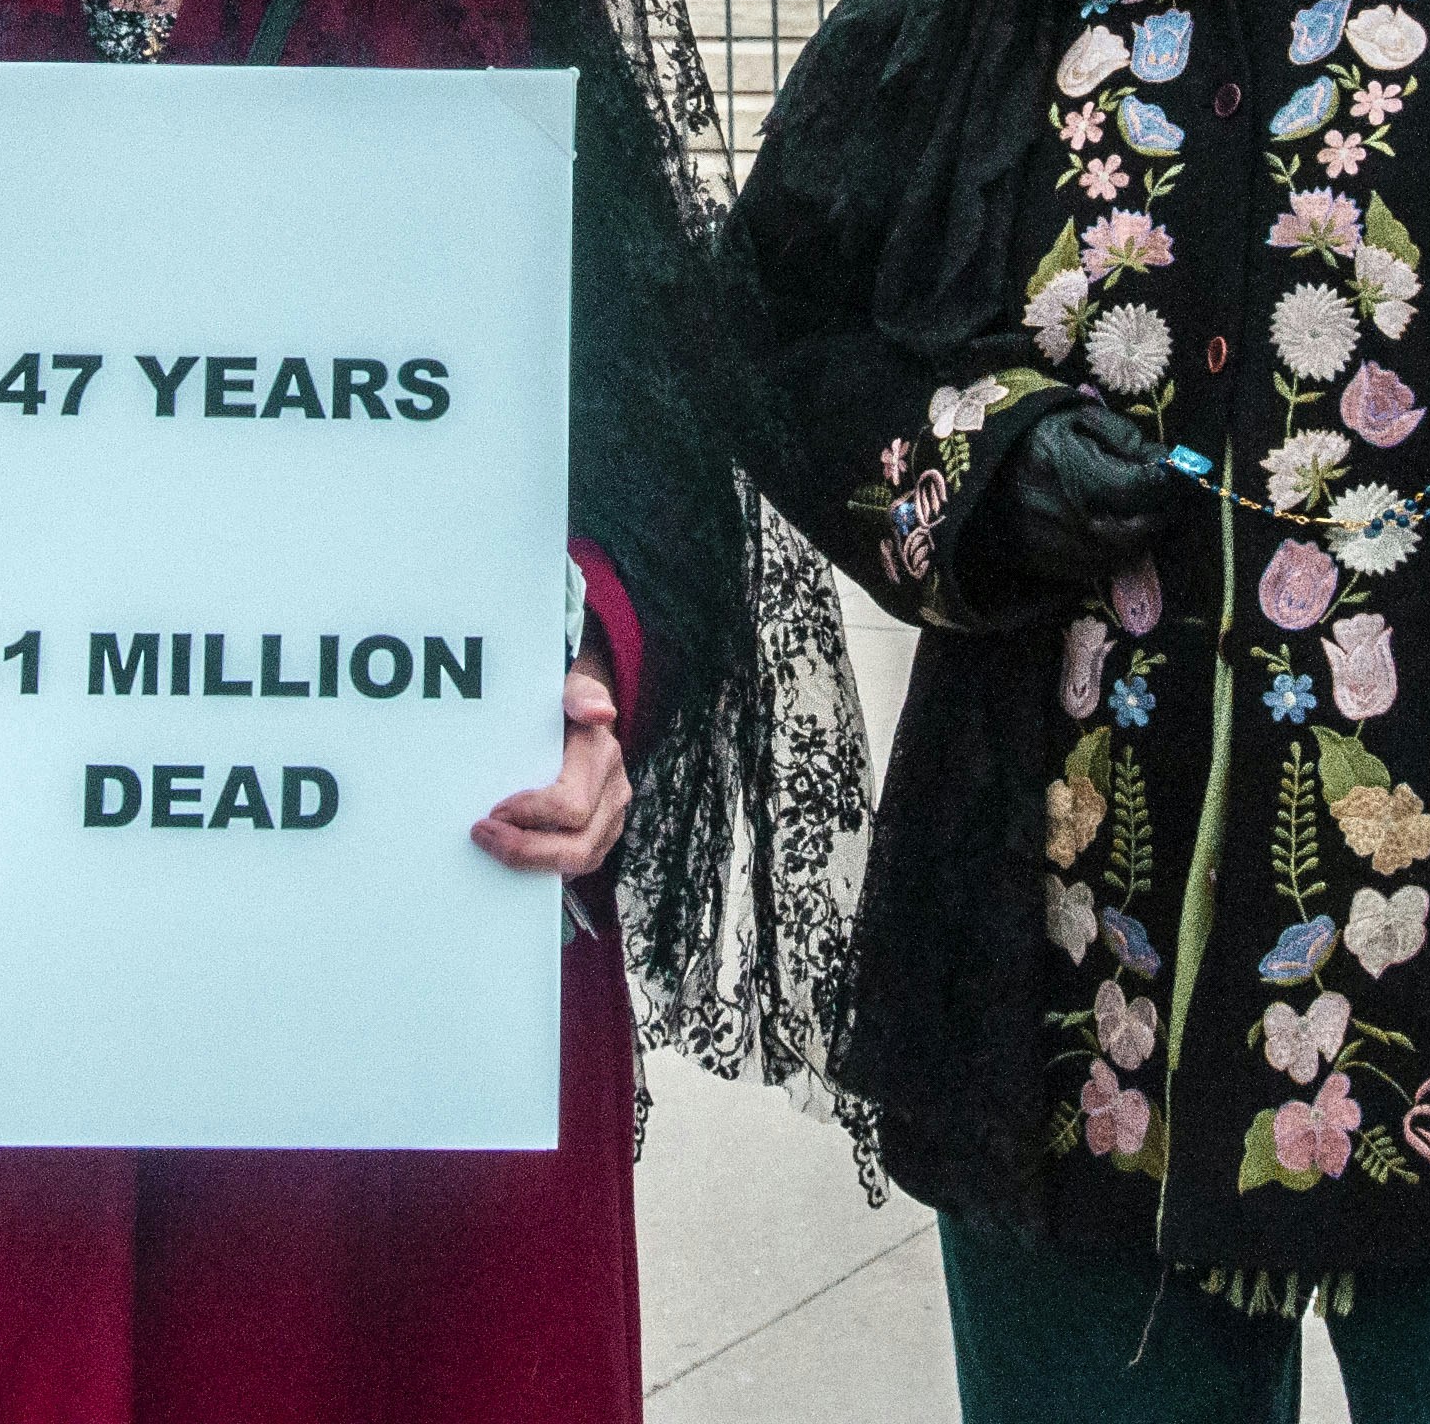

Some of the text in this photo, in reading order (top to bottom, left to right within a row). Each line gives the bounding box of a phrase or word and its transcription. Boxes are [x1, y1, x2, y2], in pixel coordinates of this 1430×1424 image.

[136, 356, 450, 421] YEARS
[89, 633, 482, 698] MILLION
[84, 765, 338, 829] DEAD
